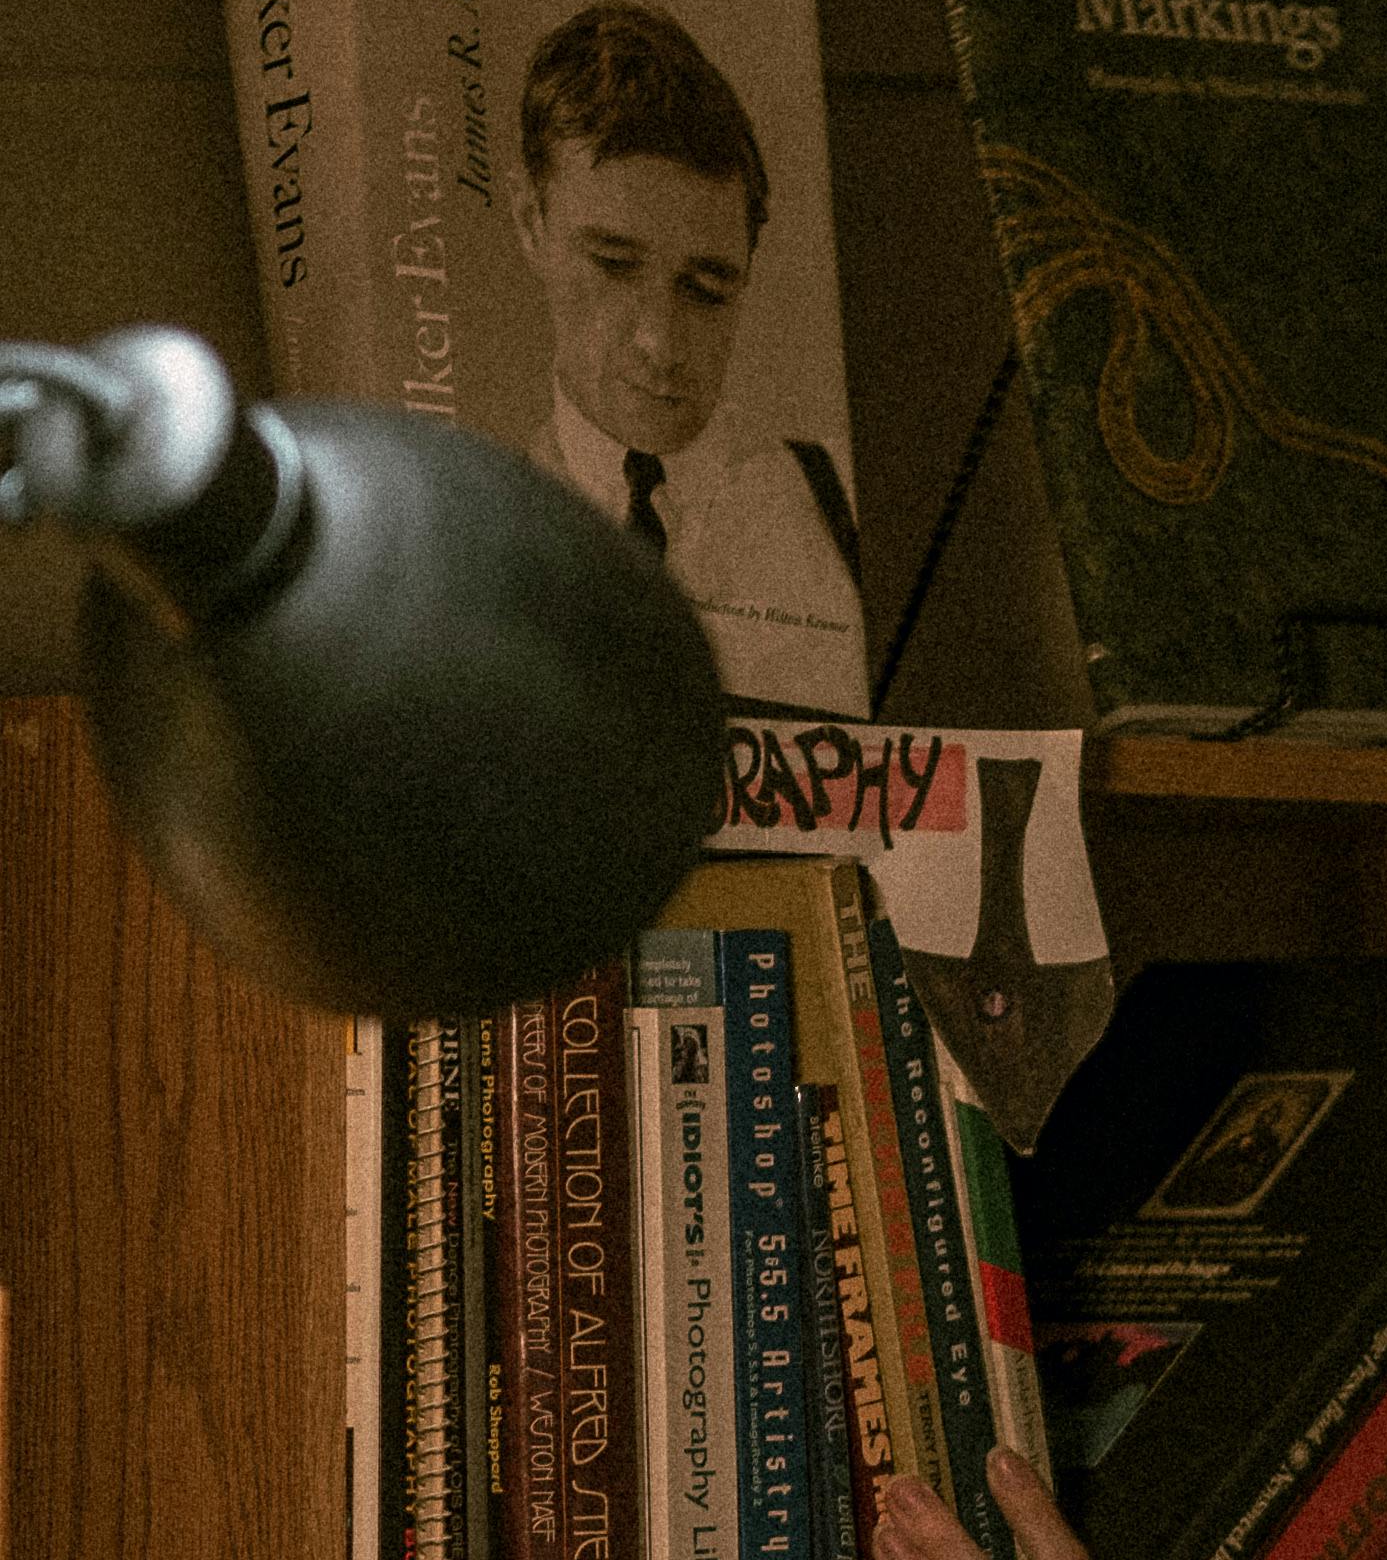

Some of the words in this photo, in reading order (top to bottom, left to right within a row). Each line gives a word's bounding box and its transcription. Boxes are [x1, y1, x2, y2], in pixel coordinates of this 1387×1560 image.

[449, 27, 482, 78] R.
[266, 90, 312, 289] Evans
[392, 93, 449, 290] Evans
[457, 80, 495, 208] James
[401, 293, 458, 429] lker
[480, 1018, 493, 1068] Lens
[523, 1074, 548, 1104] OF
[747, 951, 782, 1199] Photoshop
[480, 1074, 498, 1222] Photography
[523, 1112, 550, 1204] MODERN
[562, 995, 603, 1229] COLLECTION
[809, 1115, 825, 1190] steinke
[823, 1110, 859, 1240] TIME
[681, 1112, 705, 1244] IDIOT'S
[892, 972, 912, 1038] The
[906, 1058, 962, 1323] Reconfigured
[951, 1342, 972, 1407] Eye
[525, 1209, 552, 1355] PHOTOGRAPHY
[567, 1241, 605, 1297] OF
[488, 1363, 502, 1402] Rob
[569, 1308, 609, 1466] ALFRED
[682, 1278, 717, 1510] Photography
[835, 1243, 893, 1468] FRAMES
[1338, 1353, 1378, 1402] Press
[488, 1405, 504, 1495] Sheppard
[529, 1389, 556, 1482] WESTON
[760, 1349, 797, 1552] Artistry
[1305, 1398, 1346, 1445] Book
[531, 1489, 557, 1544] NAEF
[836, 1495, 857, 1547] wild
[1224, 1462, 1295, 1552] Newsweek
